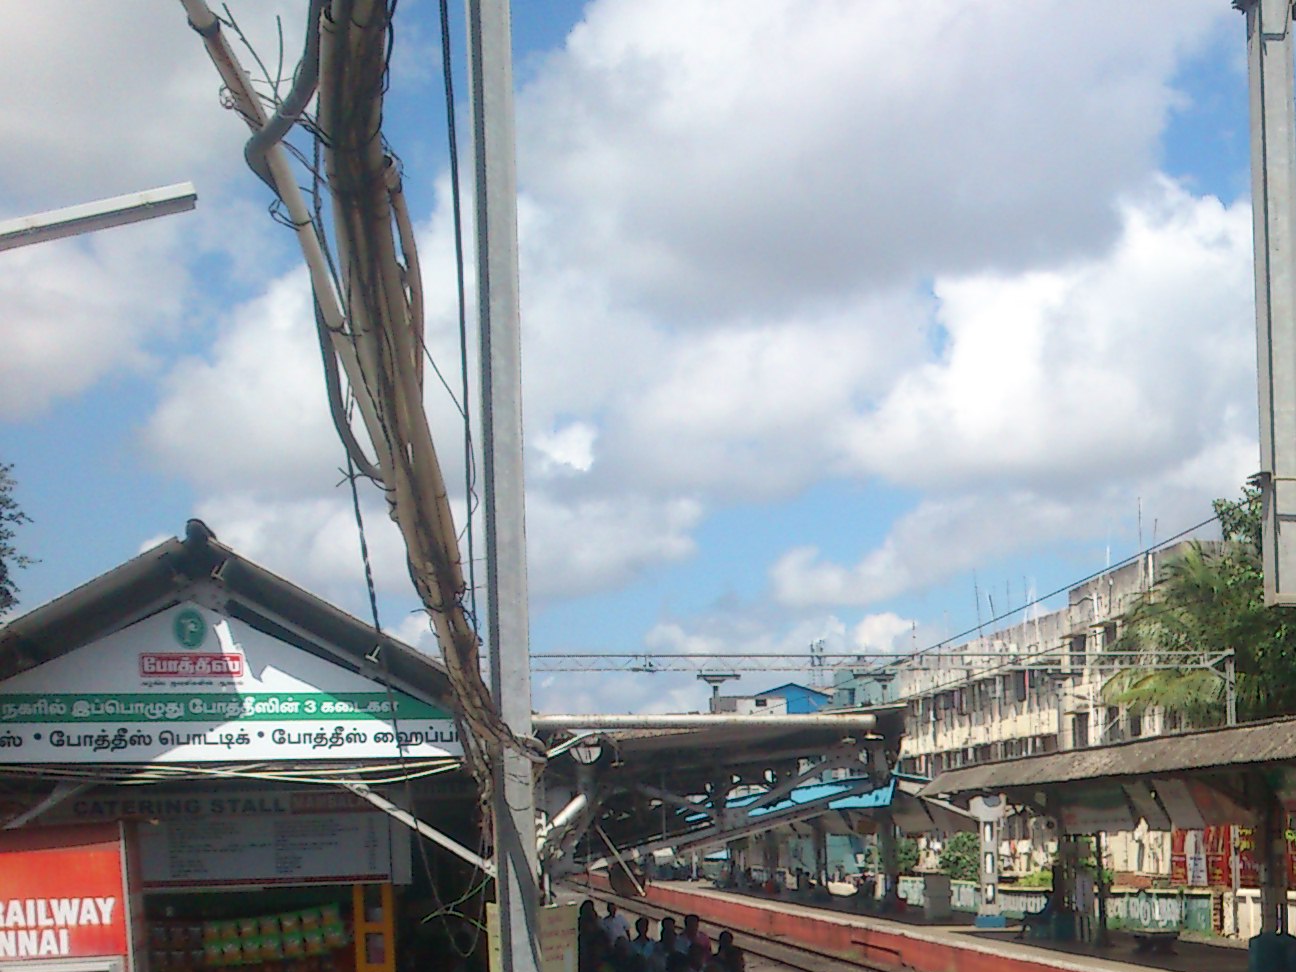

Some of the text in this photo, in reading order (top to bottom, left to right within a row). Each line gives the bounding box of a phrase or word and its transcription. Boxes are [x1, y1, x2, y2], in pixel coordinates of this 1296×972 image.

[142, 656, 241, 676] போத்தீஸ்
[304, 700, 318, 714] 3
[49, 727, 152, 752] போத்தீஸ்
[159, 727, 250, 750] பொட்டிக்
[272, 726, 367, 749] போத்தீஸ்
[73, 801, 200, 815] CATERING
[211, 799, 286, 813] STALL
